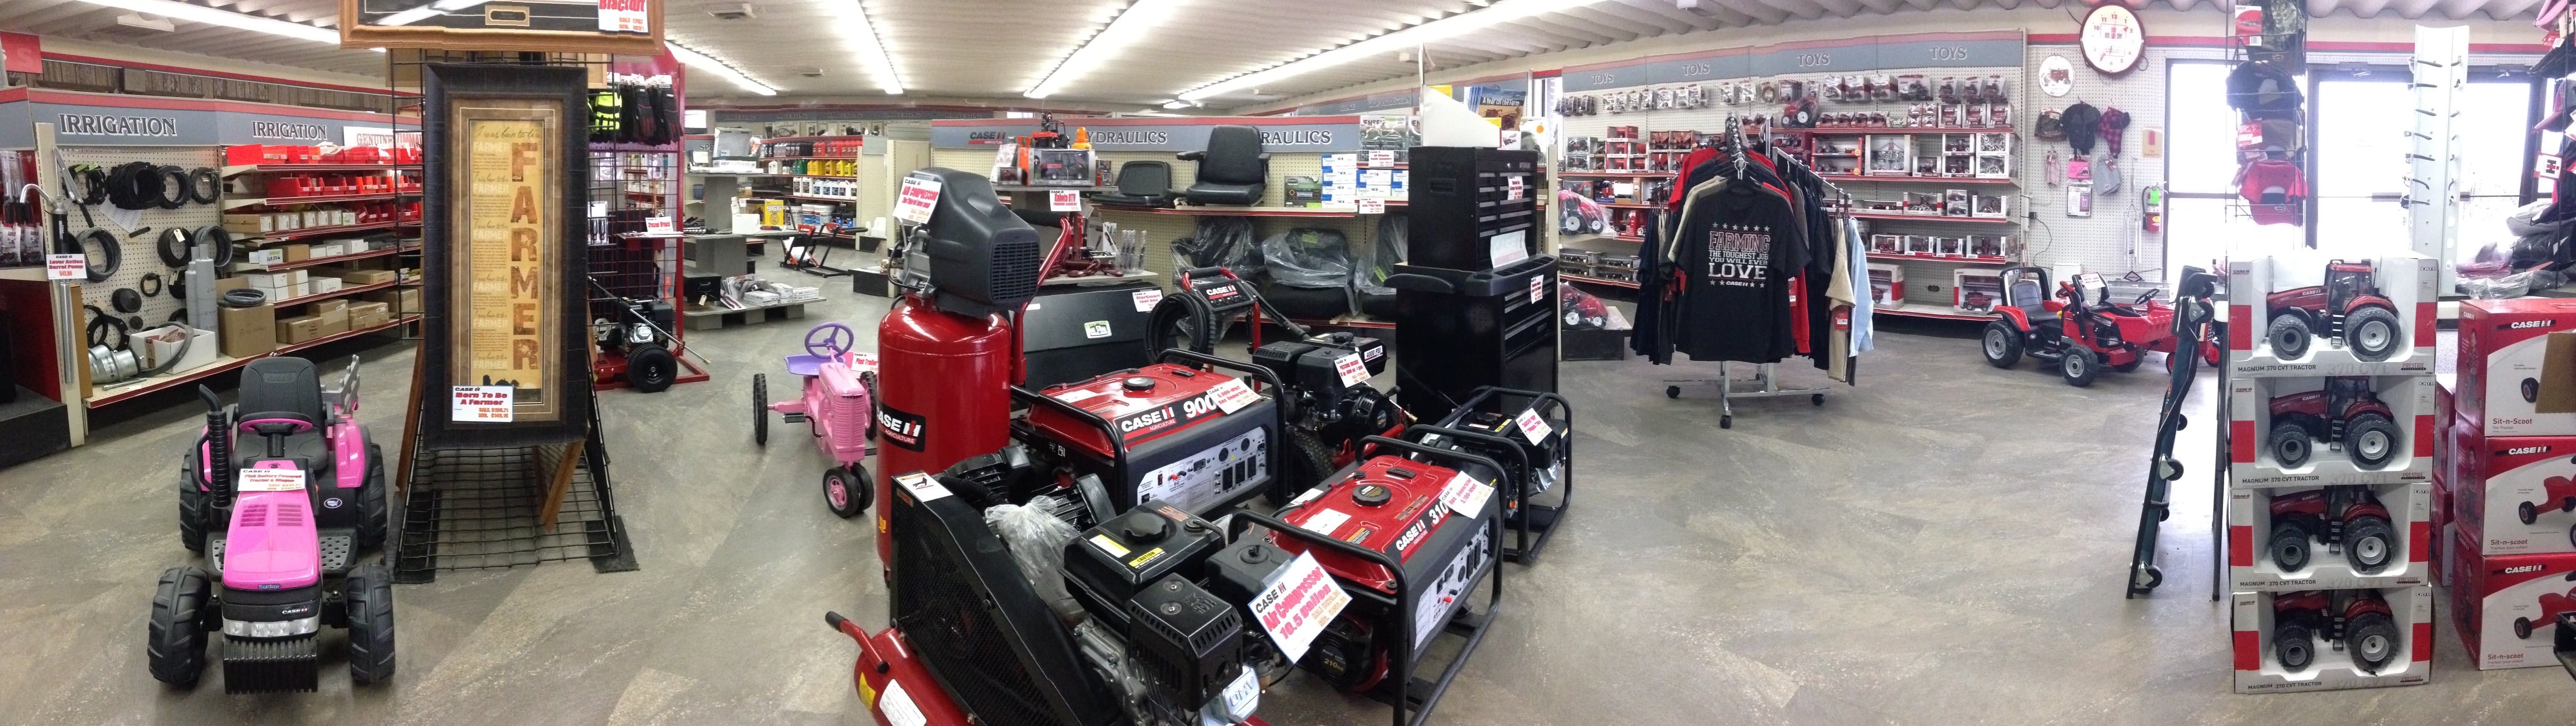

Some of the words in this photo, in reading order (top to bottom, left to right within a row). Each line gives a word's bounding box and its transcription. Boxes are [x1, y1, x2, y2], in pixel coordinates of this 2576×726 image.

[1797, 52, 1830, 67] TOYS
[1931, 46, 1968, 60] TOYS
[1683, 62, 1710, 76] TOYS
[1592, 73, 1614, 84] TOYS
[58, 113, 178, 137] IRRIGATION
[252, 121, 327, 141] IRRIGATION
[970, 131, 996, 139] CASE
[1086, 130, 1167, 144] YDRAULICS
[473, 141, 509, 152] FARMER
[473, 183, 509, 194] FARMER
[473, 230, 509, 240] FARMER
[1709, 230, 1771, 253] FARMING
[510, 142, 539, 370] FARMER
[1722, 251, 1757, 259] TOUGHEST
[1708, 262, 1768, 280] LOVE
[473, 282, 508, 291] FARMER
[1206, 286, 1229, 296] CASE
[2463, 311, 2472, 319] CASE
[473, 319, 509, 328] FARMER
[2511, 321, 2541, 329] CASE
[1121, 410, 1161, 432] CASE
[1150, 419, 1176, 431] AGRICULTURE
[885, 429, 916, 444] AGRICULTURE
[2508, 447, 2537, 455] CASE
[1441, 491, 1451, 501] CASE
[1448, 497, 1457, 505] Gas
[1456, 478, 1472, 497] Generator
[1396, 528, 1420, 551] CASE
[1412, 529, 1428, 545] AGRICULTURE
[1136, 551, 1156, 563] CAUTION
[1256, 589, 1279, 613] CASE
[1263, 608, 1281, 632] Air
[1274, 566, 1324, 619] Compressor
[1280, 613, 1303, 640] 10.5
[1229, 676, 1255, 707] OHV
